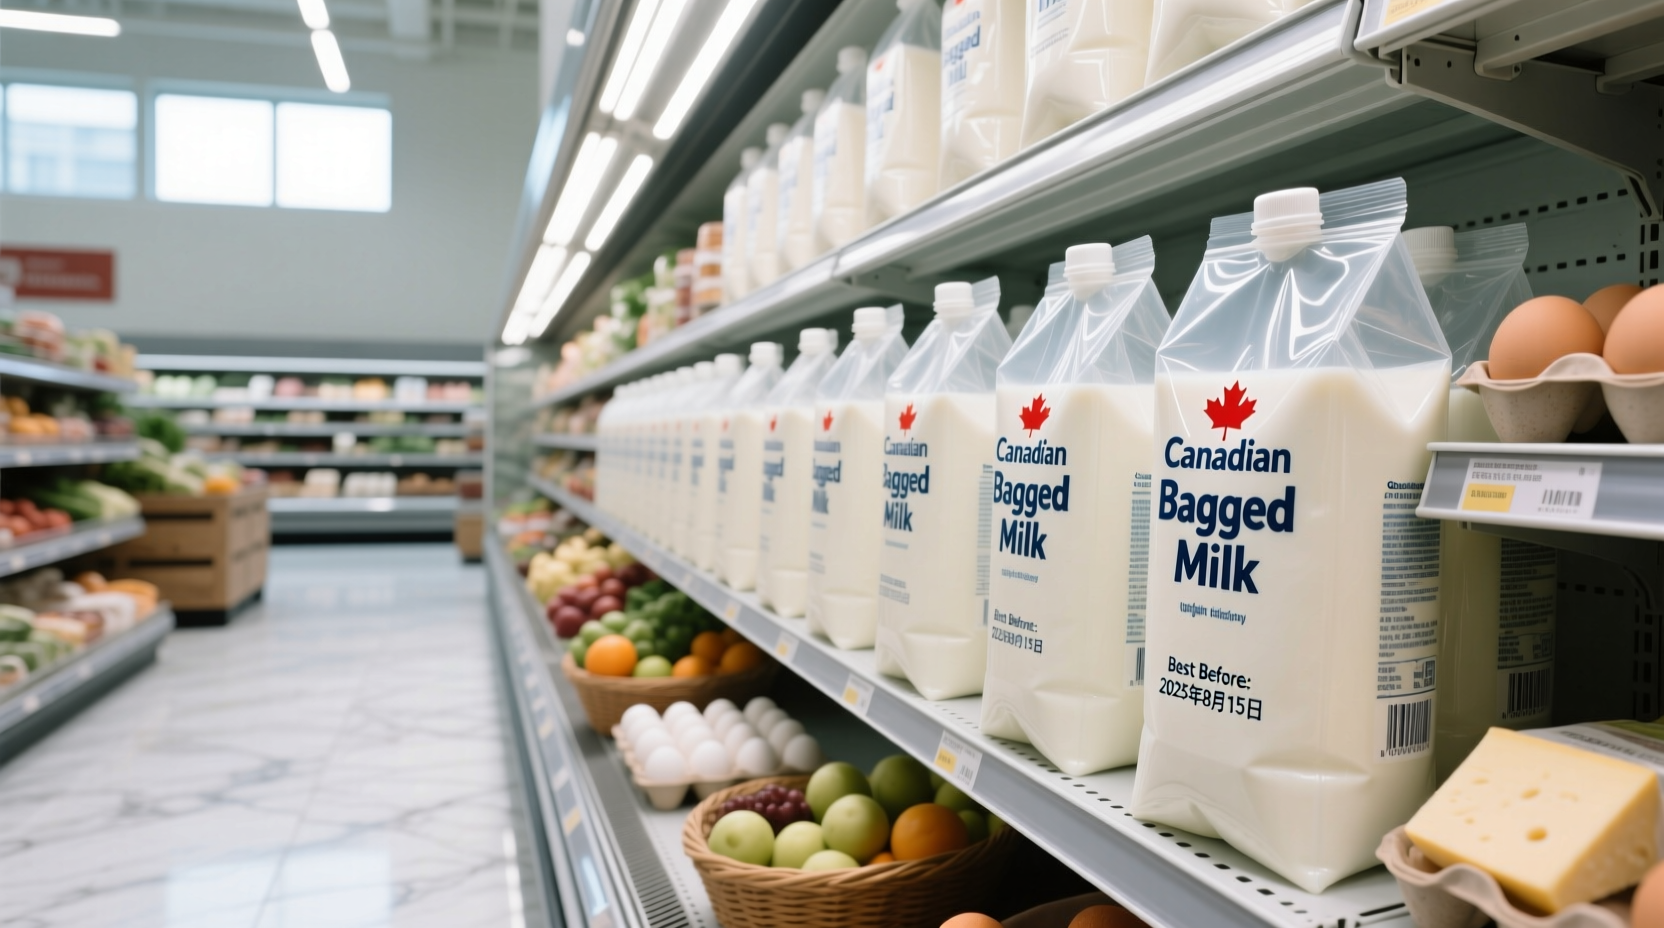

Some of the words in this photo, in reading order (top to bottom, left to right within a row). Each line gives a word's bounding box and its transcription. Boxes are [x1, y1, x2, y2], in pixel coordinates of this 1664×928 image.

[996, 437, 1067, 466] Canadian
[1165, 436, 1291, 473] Canadian
[993, 470, 1070, 518] Bagged
[1159, 479, 1296, 540] Bagged
[883, 501, 913, 532] Milk
[999, 518, 1047, 560] Milk
[1174, 539, 1260, 594] Milk
[1168, 656, 1196, 678] Best
[1199, 662, 1251, 690] Before:
[1159, 677, 1262, 721] 2025年8月15日
